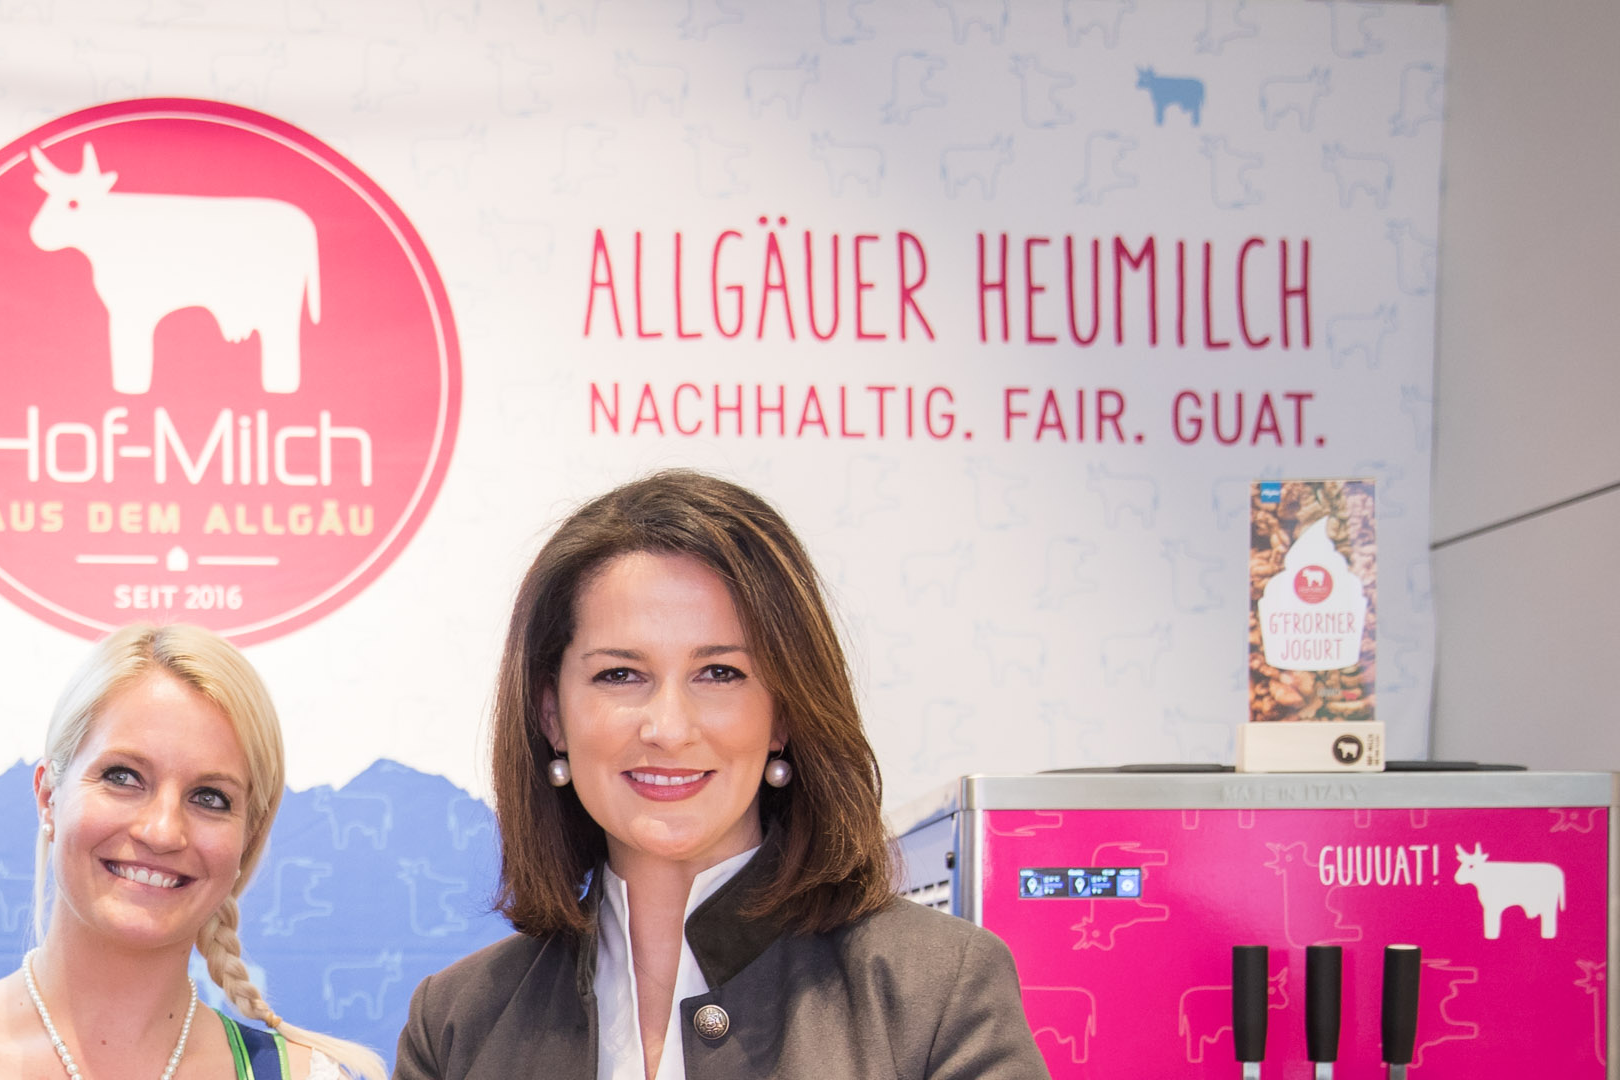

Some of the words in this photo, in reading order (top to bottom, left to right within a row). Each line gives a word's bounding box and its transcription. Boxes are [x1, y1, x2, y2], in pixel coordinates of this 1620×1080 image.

[583, 216, 936, 342] ALLGÄUER
[979, 232, 1313, 350] HEUMILCH
[588, 382, 975, 441] NACHHALTIG.
[1002, 388, 1146, 444] FAIR.
[1174, 390, 1327, 448] GUAT.
[88, 502, 181, 534] DEM
[203, 499, 375, 537] ALLGÄU
[113, 585, 178, 609] SEIT
[184, 585, 244, 611] 2016
[1280, 639, 1343, 661] JOGURT
[1319, 844, 1439, 886] GUUUAT!
